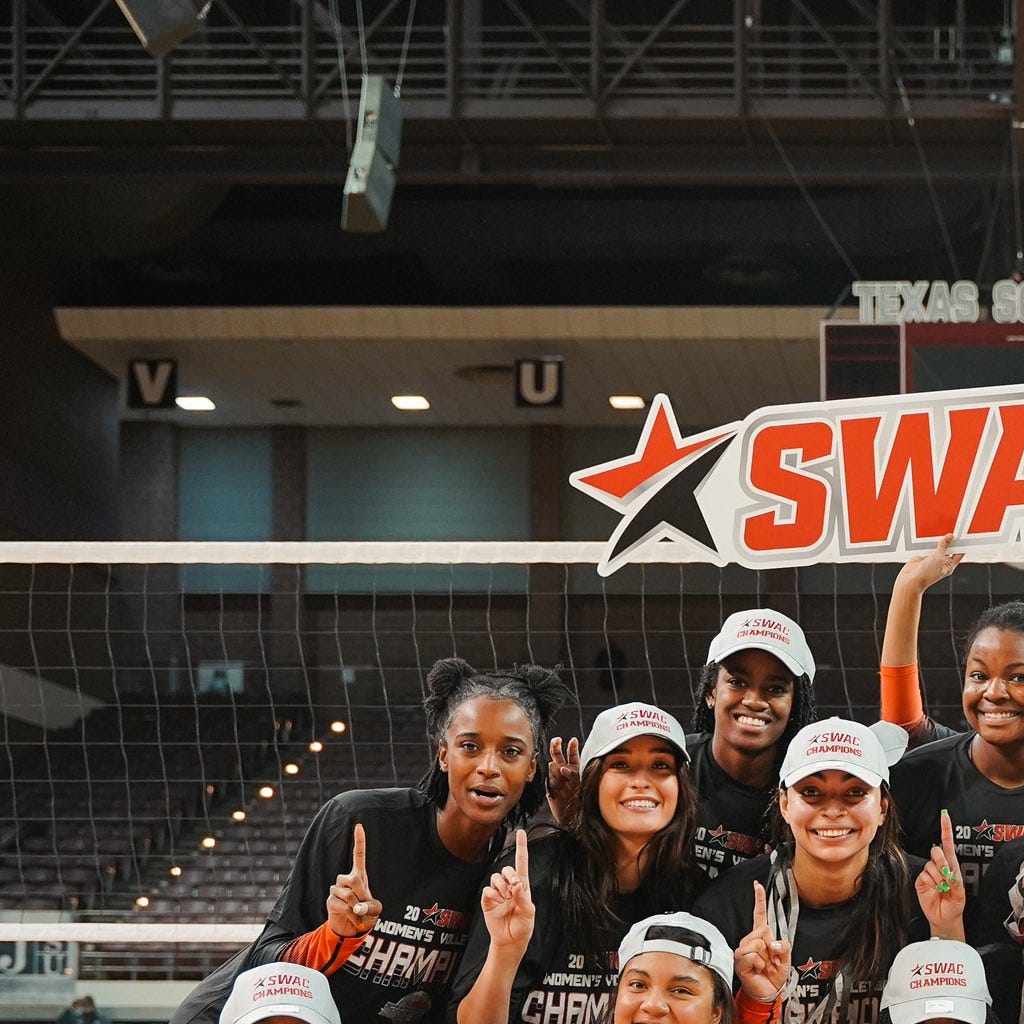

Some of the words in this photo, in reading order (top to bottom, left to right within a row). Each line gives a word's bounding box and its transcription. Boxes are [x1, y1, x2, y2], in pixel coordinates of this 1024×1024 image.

[852, 280, 979, 324] TEXAS
[133, 361, 173, 404] V
[519, 361, 558, 403] U
[752, 618, 790, 635] SWAC
[736, 630, 791, 645] CHAMPIONS
[630, 709, 668, 724] SWAC
[616, 720, 671, 733] CHAMPIONS
[821, 732, 861, 747] SWAC
[806, 745, 863, 758] CHAMPIONS
[956, 825, 971, 840] 20
[955, 843, 994, 858] MEN'S
[404, 905, 420, 922] 20
[374, 918, 435, 943] WOMEN'S
[347, 935, 459, 984] CHAMPI
[568, 953, 585, 970] 20
[924, 962, 964, 976] SWAC
[267, 974, 310, 989] SWAC
[542, 972, 602, 988] WOMEN'S
[910, 976, 967, 990] CHAMPIONS
[252, 987, 314, 1002] CHAMPIONS
